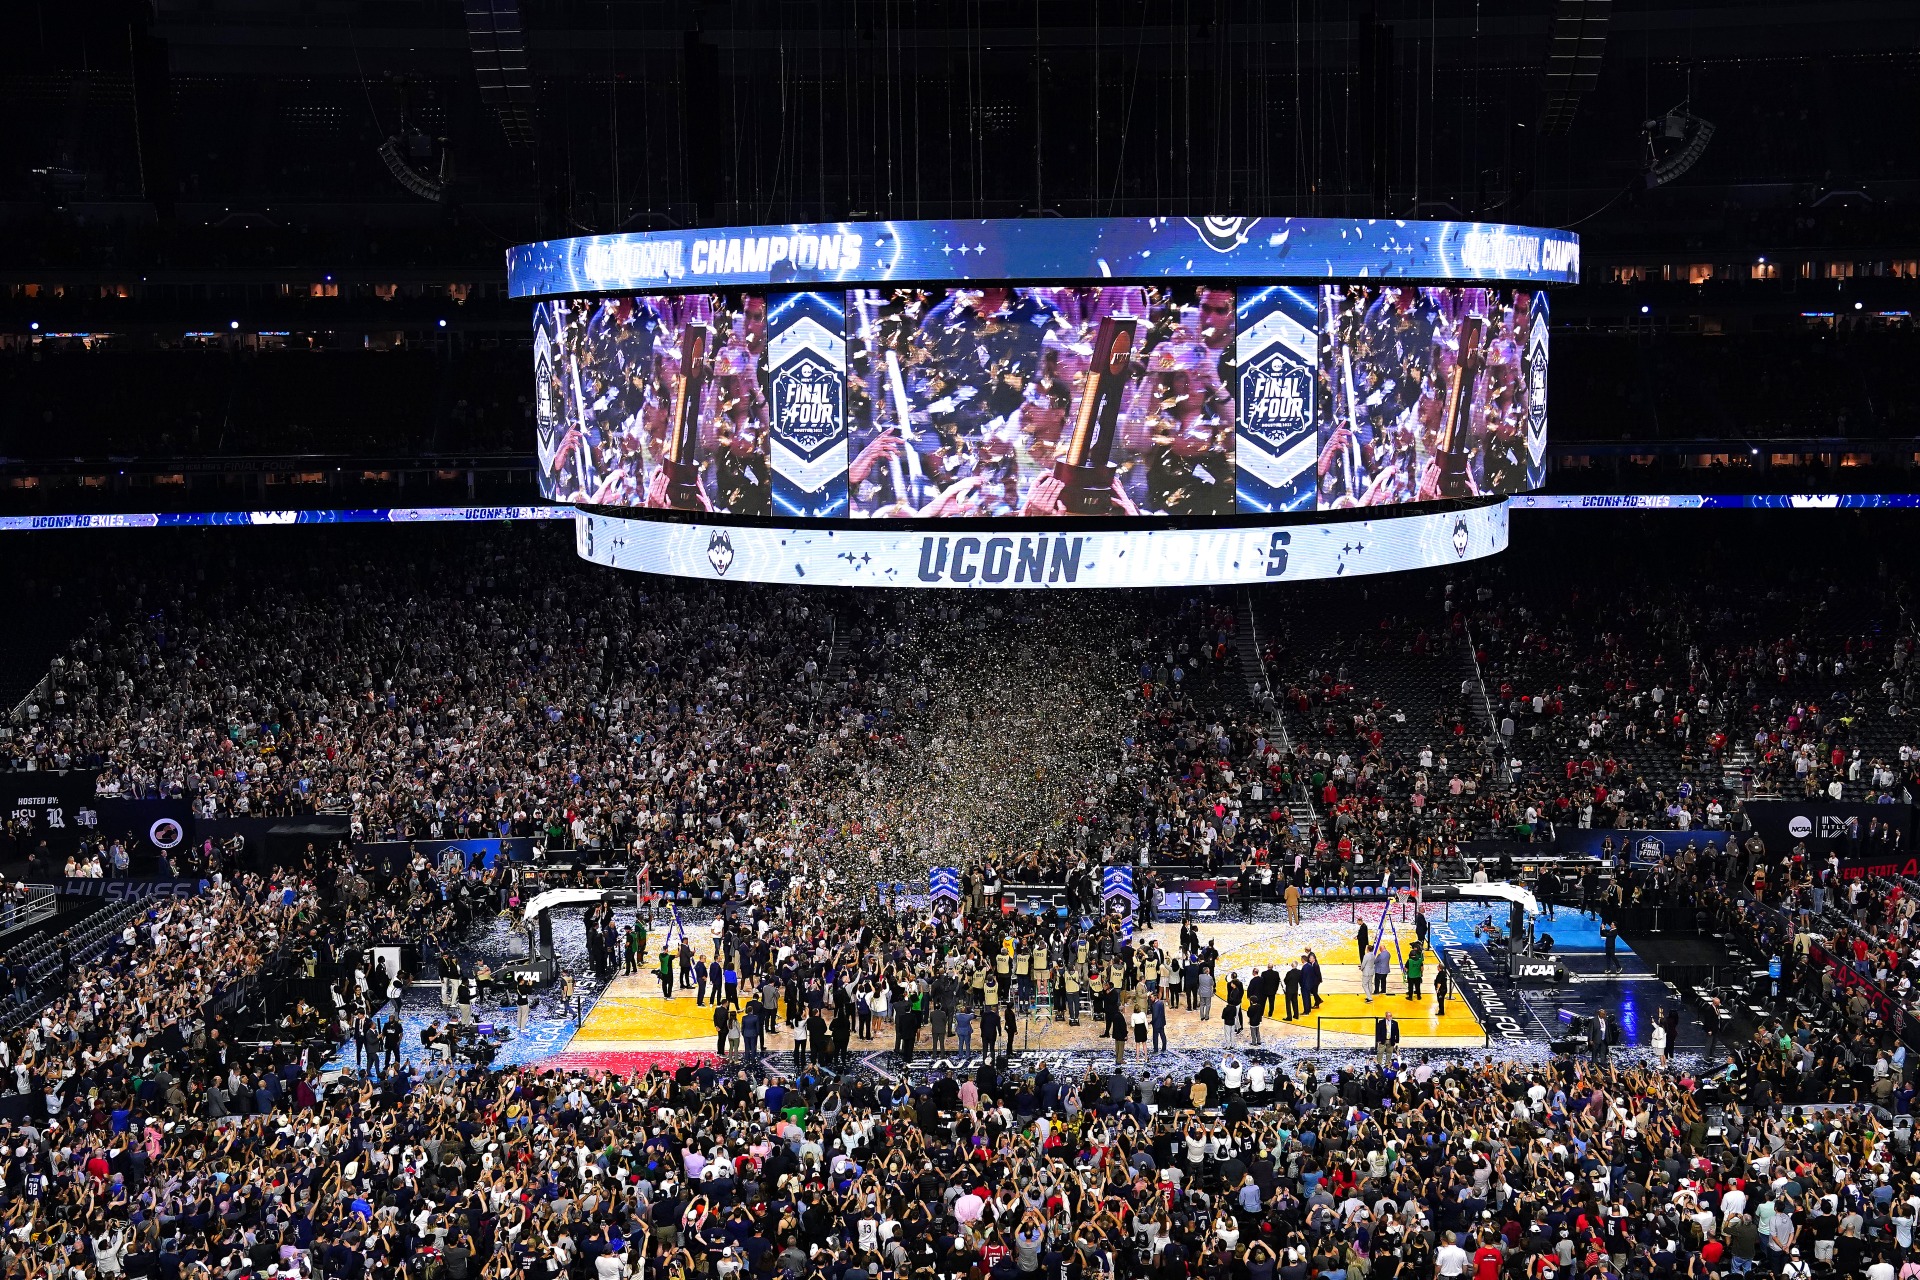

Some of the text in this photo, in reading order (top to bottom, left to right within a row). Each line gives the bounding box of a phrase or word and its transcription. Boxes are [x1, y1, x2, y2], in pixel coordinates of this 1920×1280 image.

[691, 235, 862, 274] CHAMPIONS
[786, 383, 829, 403] FINAL
[1255, 377, 1300, 398] FINAL
[789, 403, 833, 424] FOUR
[1257, 397, 1303, 419] FOUR
[918, 532, 1291, 582] UCONN HUSKIES
[12, 809, 36, 819] HCU
[1867, 863, 1898, 877] STATE
[65, 880, 191, 901] HUSKIES
[1518, 964, 1556, 976] NCAA
[1468, 982, 1508, 1014] FINAL
[27, 1182, 38, 1196] 32
[863, 1224, 872, 1234] 13
[1607, 1224, 1615, 1236] 15
